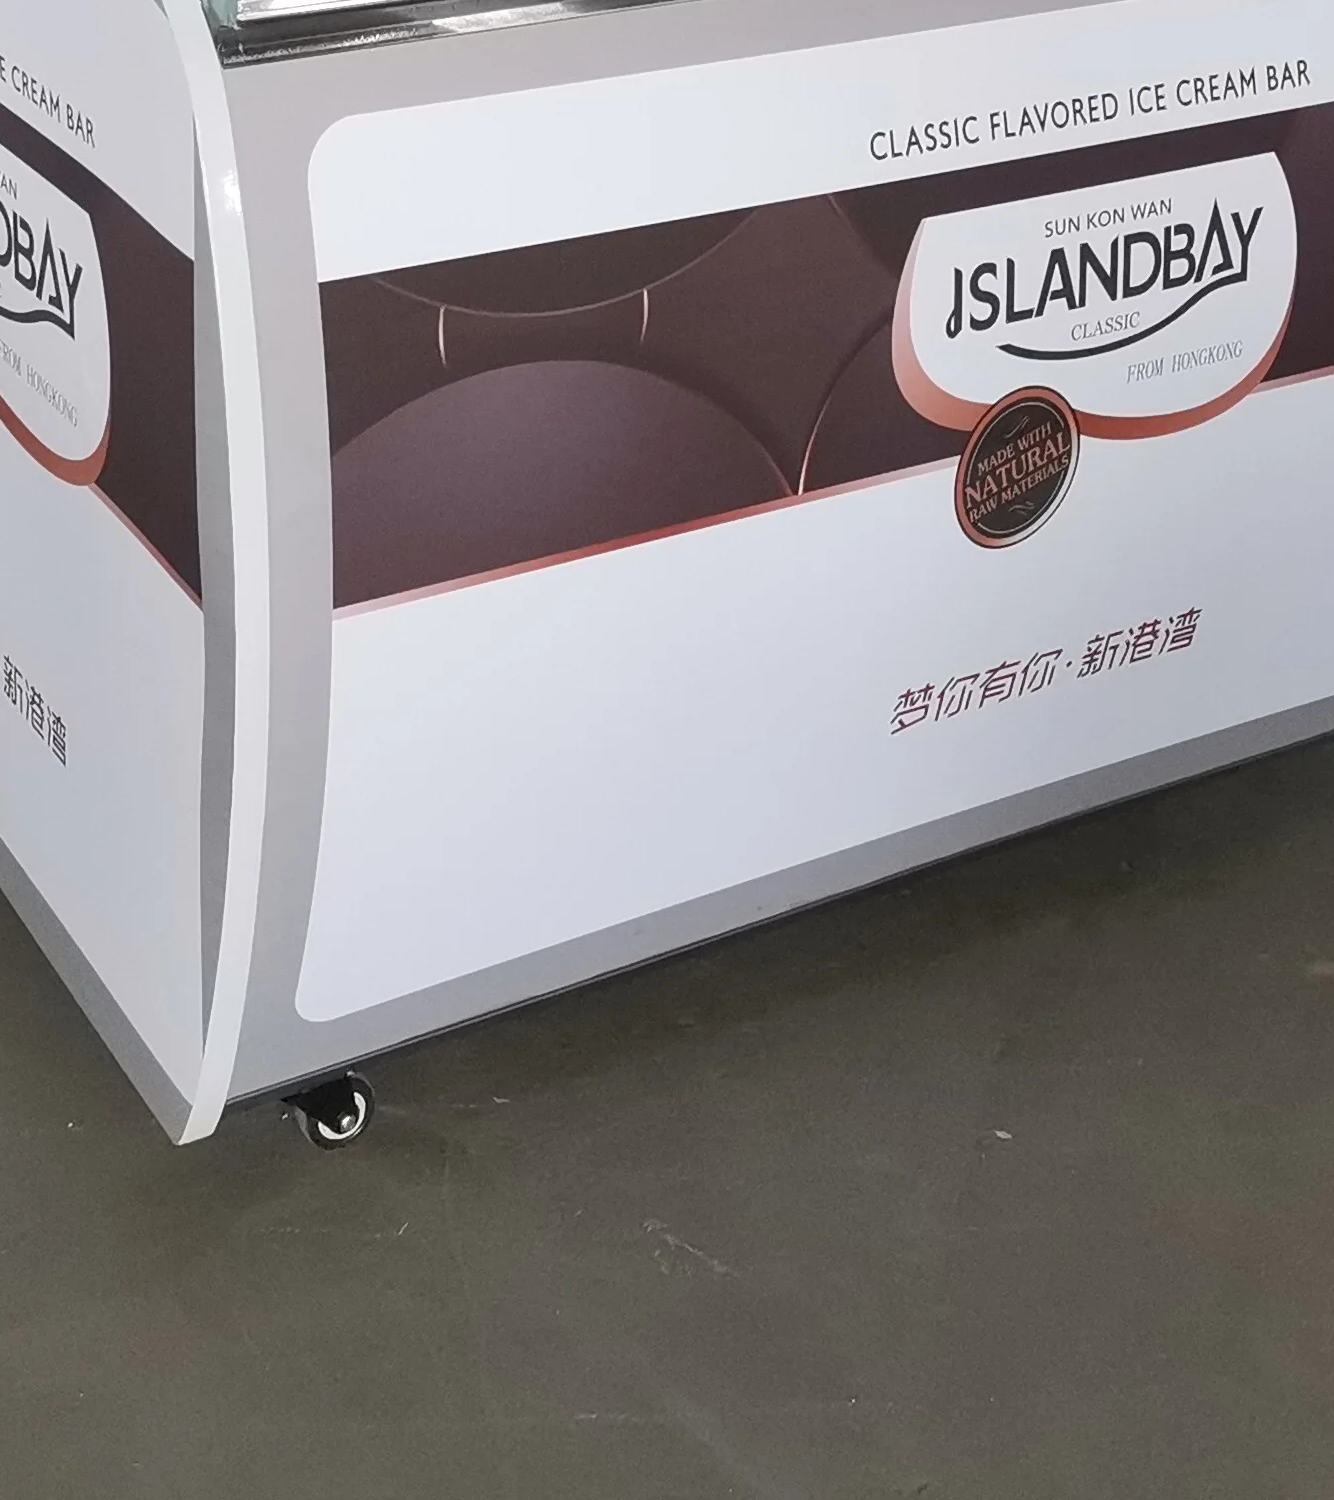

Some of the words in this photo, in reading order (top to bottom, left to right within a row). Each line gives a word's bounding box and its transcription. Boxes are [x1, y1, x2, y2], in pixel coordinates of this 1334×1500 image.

[12, 66, 61, 122] CREAM
[67, 102, 96, 149] BAR
[869, 116, 980, 161] CLASSIC
[989, 92, 1118, 142] FLAVORED
[1129, 83, 1168, 118] ICE
[1176, 68, 1258, 107] CREAM
[1266, 60, 1312, 92] BAR
[1044, 215, 1081, 239] SUN
[1086, 207, 1126, 231] KON
[1130, 197, 1173, 221] WAN
[1070, 311, 1141, 342] CLASSIC
[26, 362, 78, 428] HONGKONG
[1126, 360, 1164, 384] FROM
[1171, 340, 1244, 373] HONGKONG
[965, 432, 1071, 510] NATURAL
[977, 443, 1016, 476] MADE
[1017, 421, 1052, 451] WITH
[969, 495, 998, 523] RAW
[1001, 454, 1070, 505] MATERIALS
